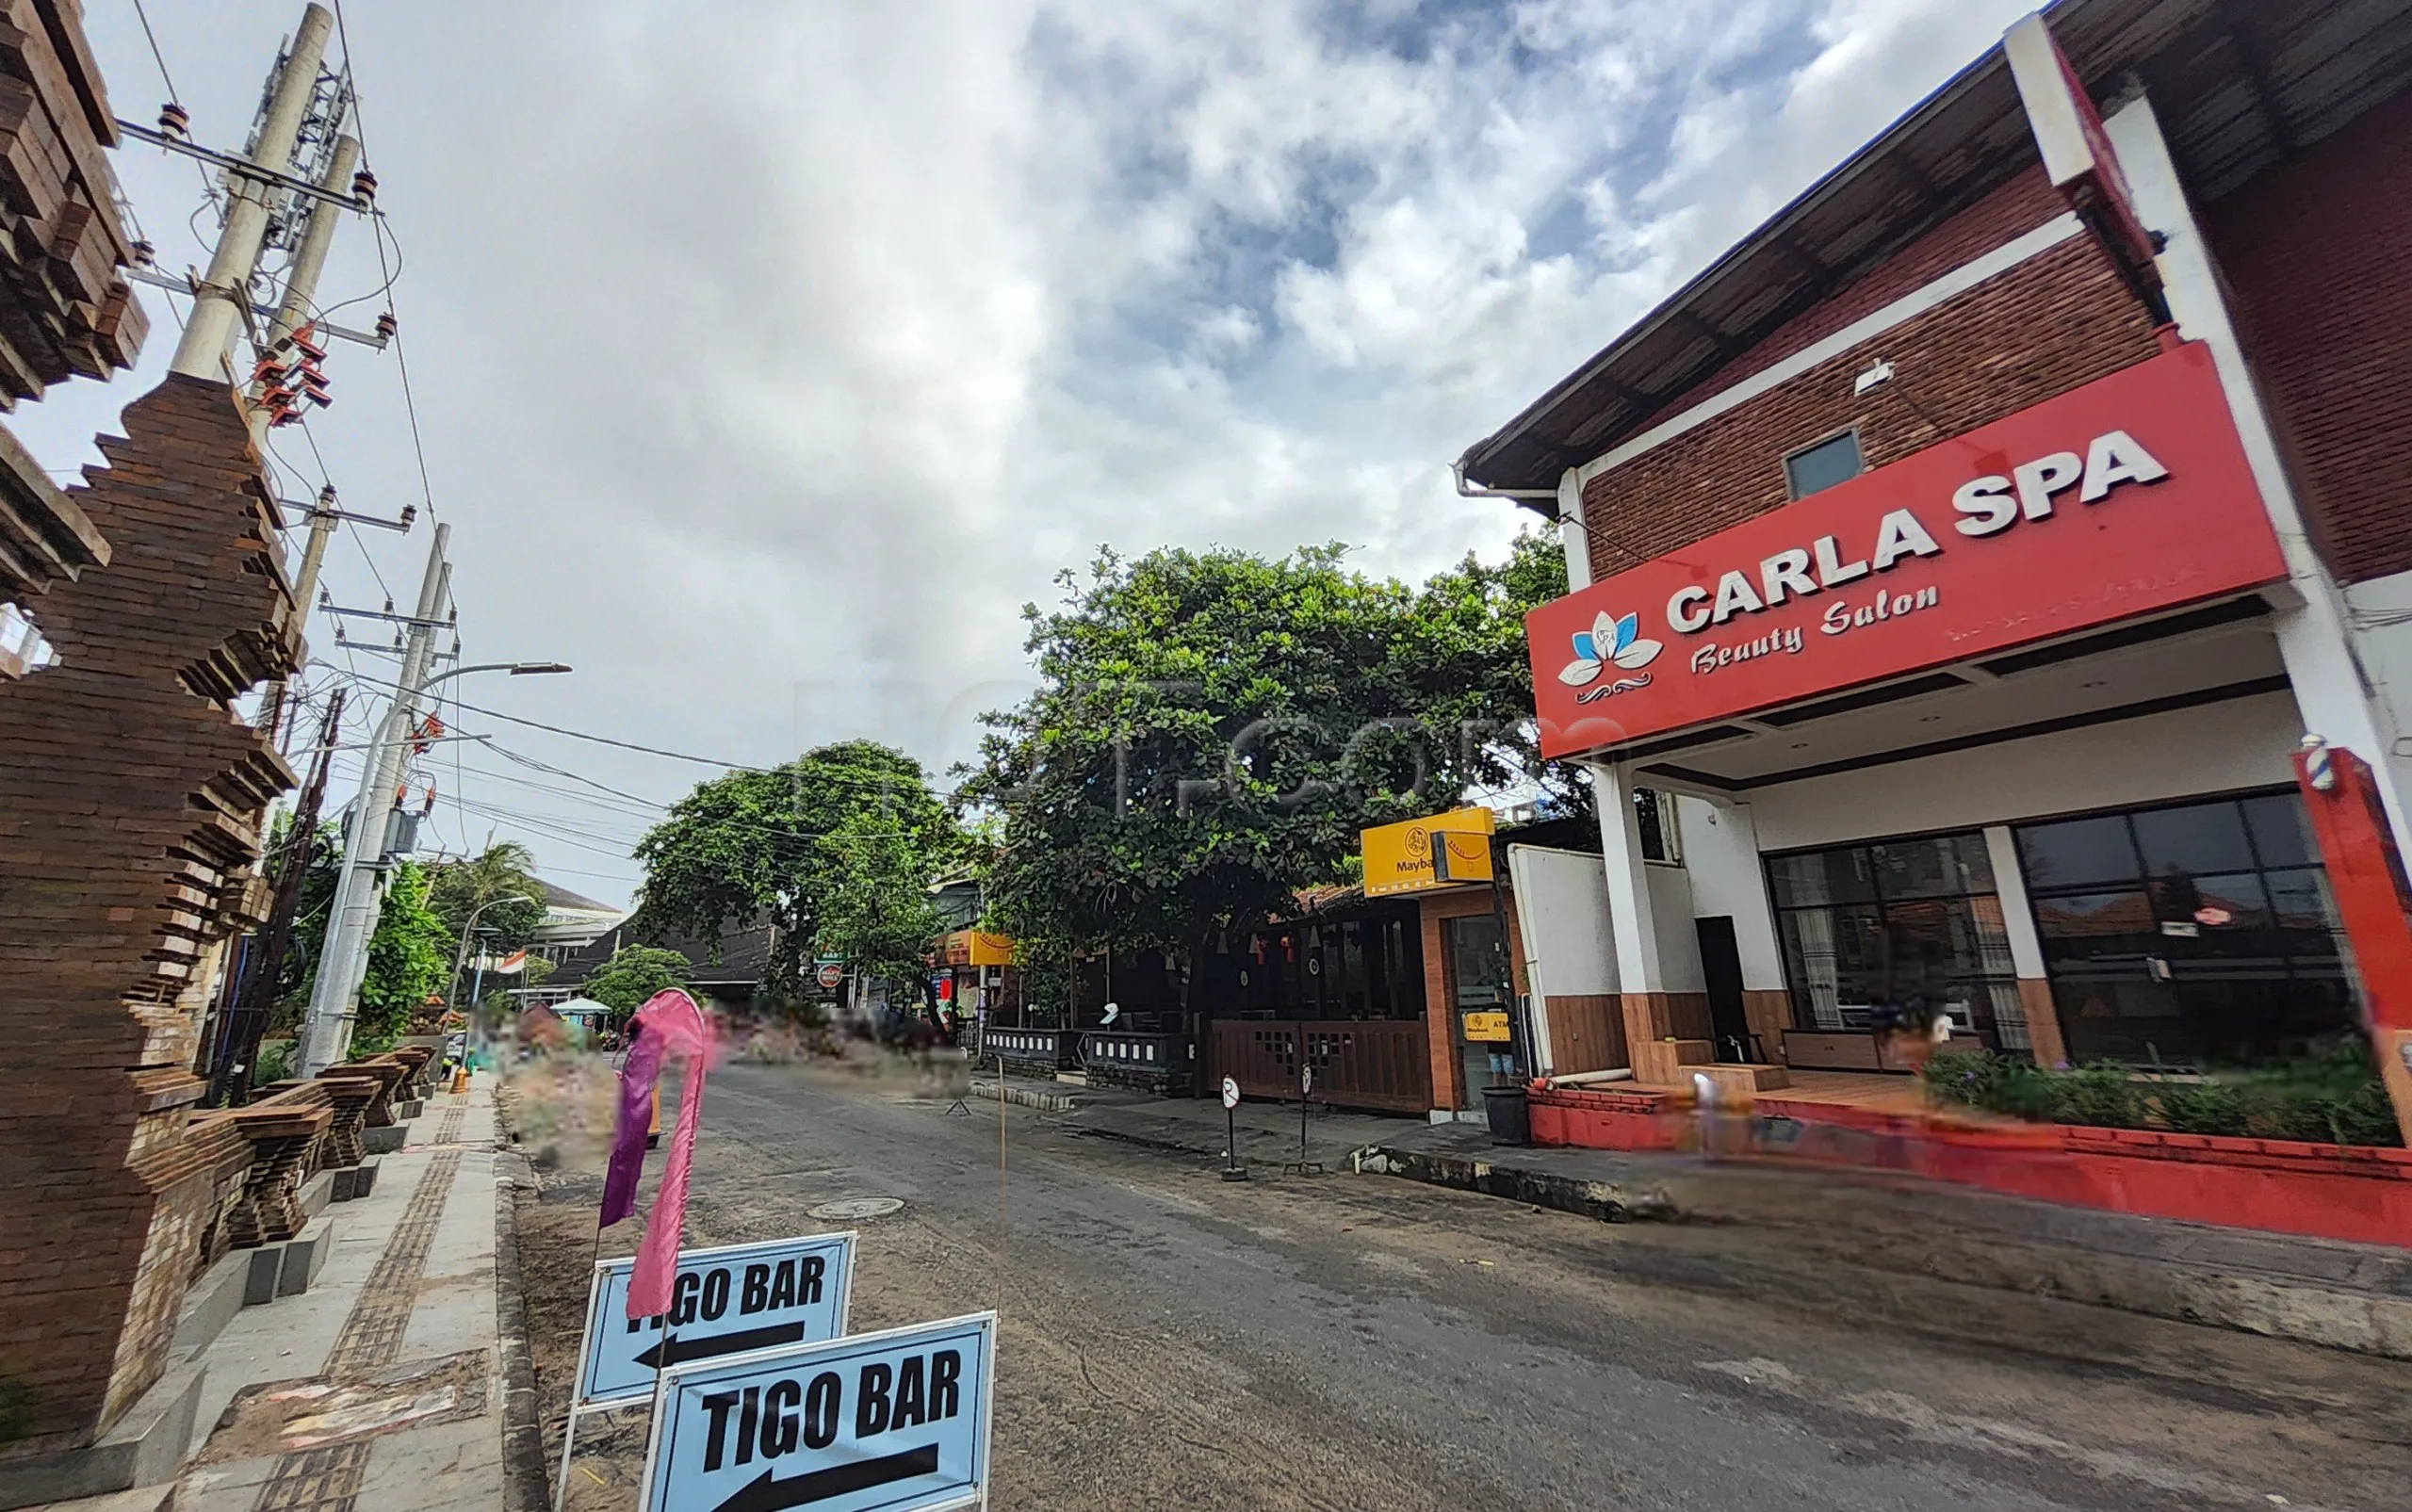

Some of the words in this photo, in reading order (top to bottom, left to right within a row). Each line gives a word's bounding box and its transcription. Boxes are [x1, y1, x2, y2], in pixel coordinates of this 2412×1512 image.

[1666, 508, 1941, 633] CARLA
[1952, 431, 2169, 537] SPA
[1690, 623, 1803, 675] Beauty
[1819, 585, 1940, 636] Salon
[1396, 857, 1434, 874] Mayba
[626, 1269, 731, 1334] GO
[740, 1256, 825, 1315] BAR
[701, 1372, 842, 1473] TIGO
[856, 1349, 962, 1439] BAR
